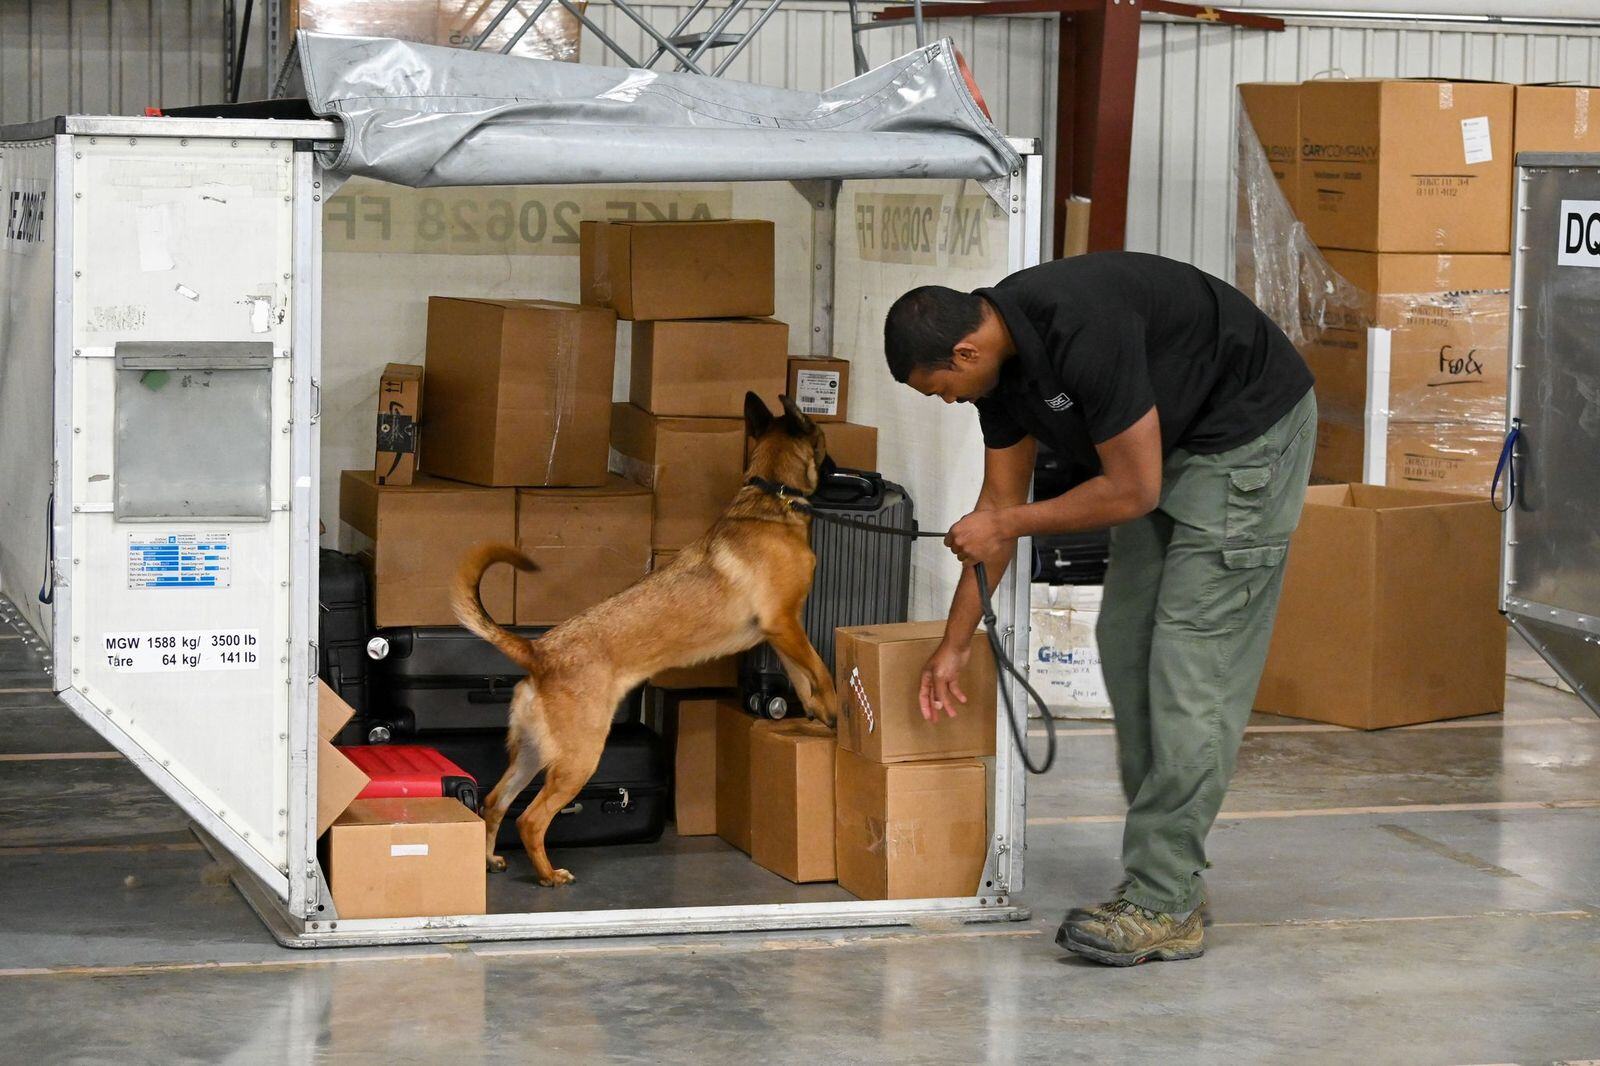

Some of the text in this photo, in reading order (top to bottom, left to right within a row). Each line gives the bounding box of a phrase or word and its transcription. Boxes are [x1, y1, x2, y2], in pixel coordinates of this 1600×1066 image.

[106, 634, 256, 650] MGW 1588 kg/ 3500 lb
[107, 651, 256, 667] Tare 64 kg/ 141 lb
